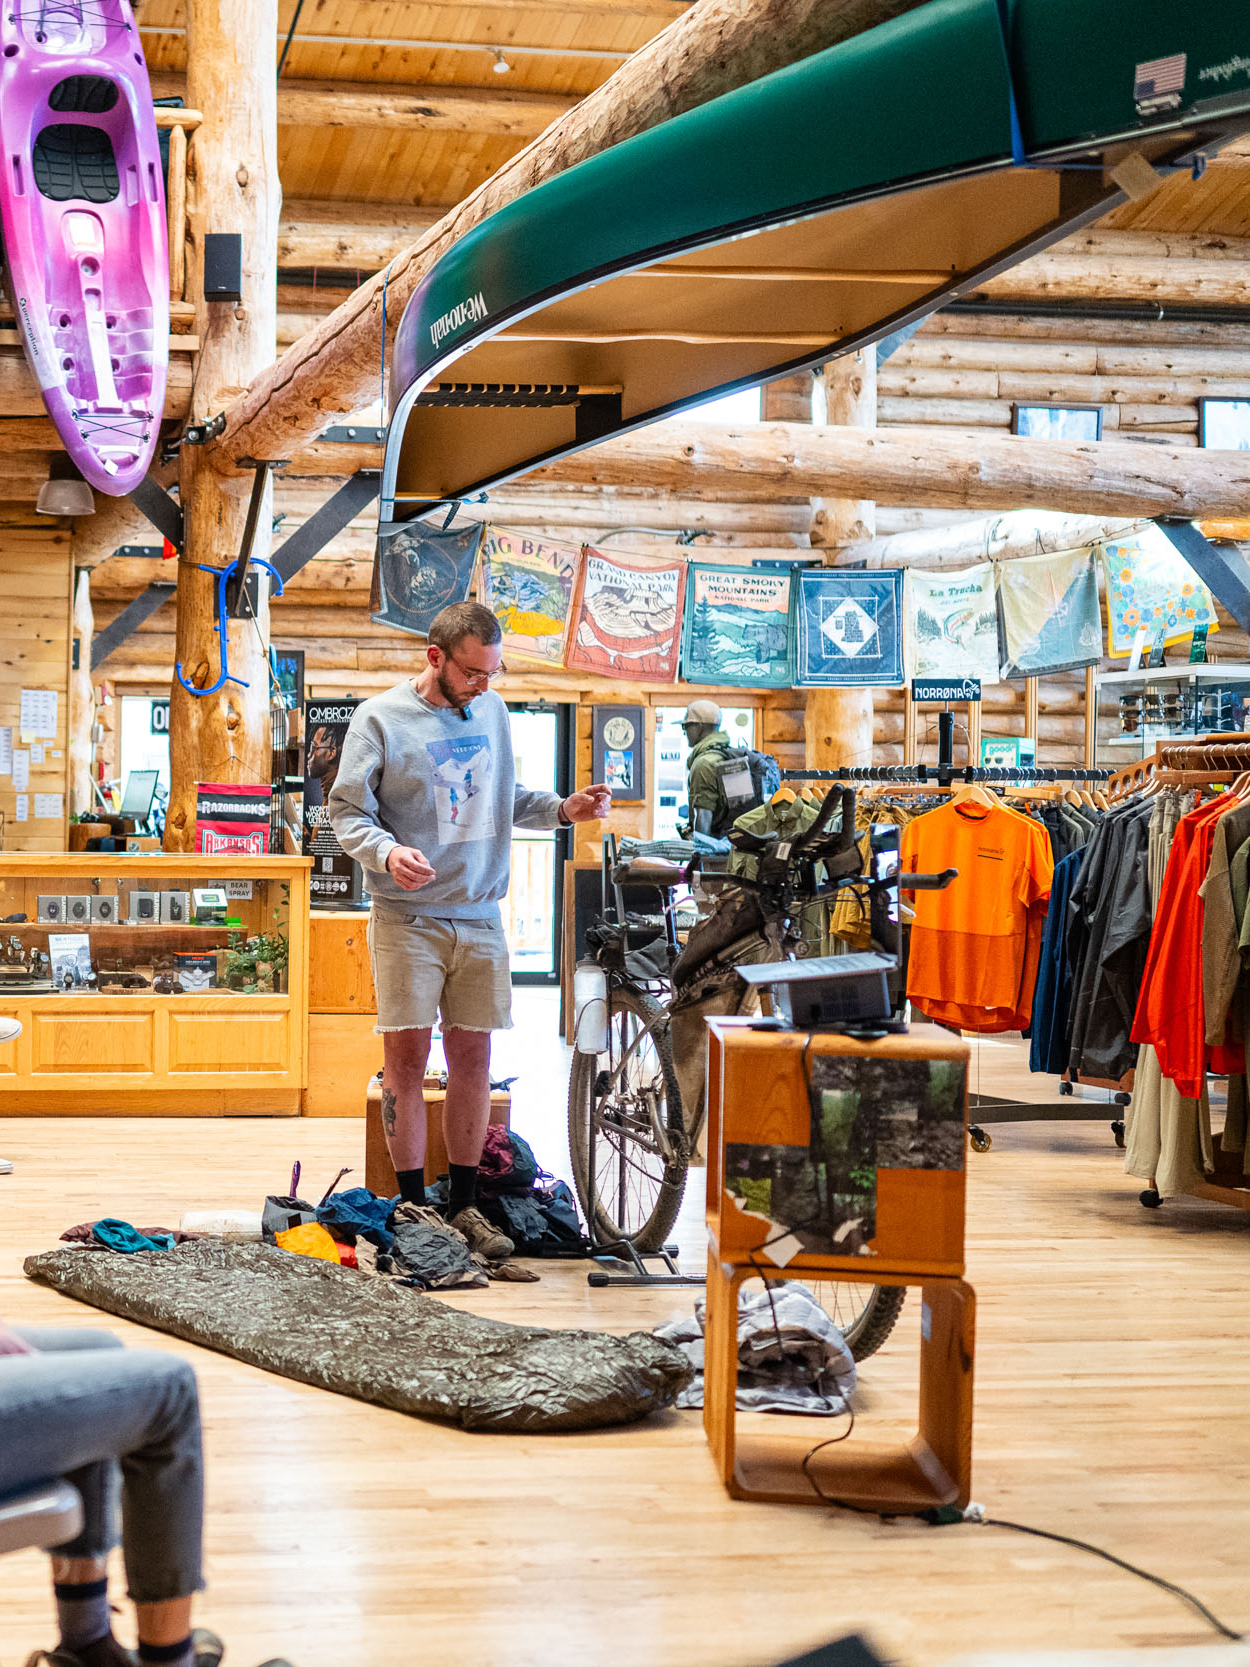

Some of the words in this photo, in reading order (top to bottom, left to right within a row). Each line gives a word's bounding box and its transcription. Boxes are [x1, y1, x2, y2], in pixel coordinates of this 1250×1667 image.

[589, 559, 626, 577] GRAND
[700, 574, 737, 584] GREAT
[743, 577, 785, 587] SMOKY
[648, 582, 674, 593] PARK
[708, 585, 777, 597] MOUNTAINS
[929, 589, 944, 597] La
[915, 687, 965, 699] NORRØNA
[201, 800, 267, 817] RAZORBACKS
[204, 831, 261, 855] ARKANSAS
